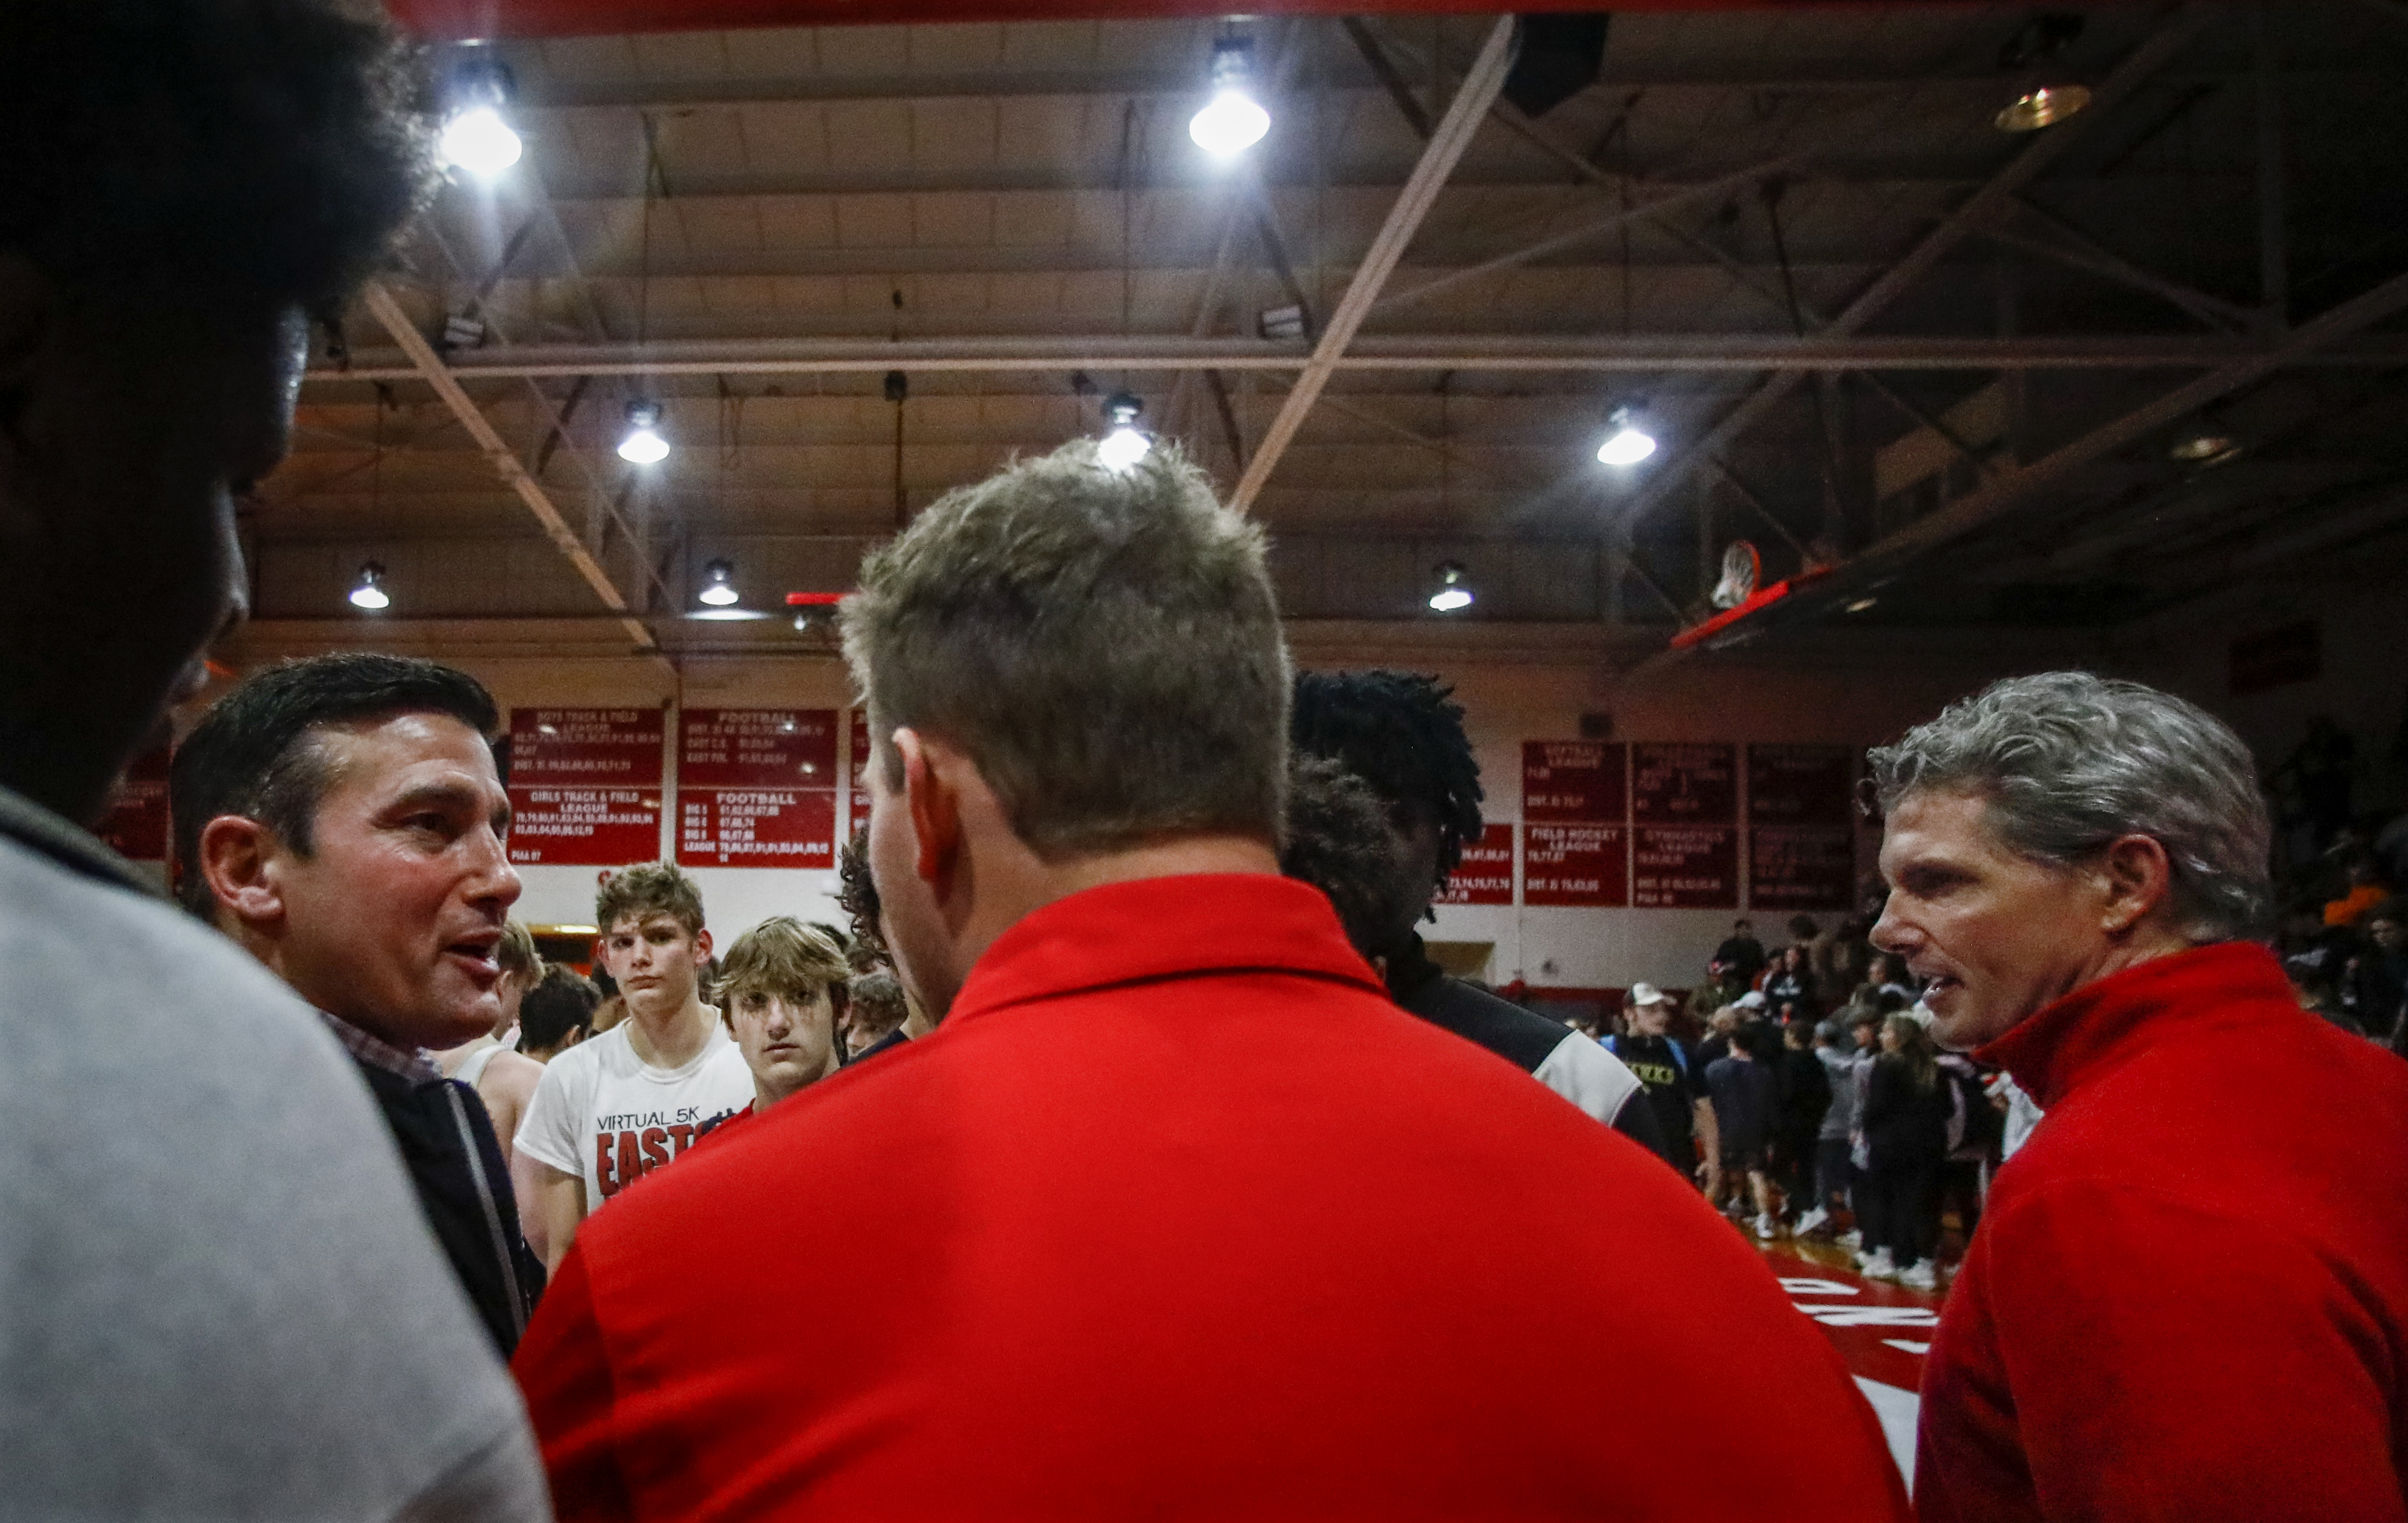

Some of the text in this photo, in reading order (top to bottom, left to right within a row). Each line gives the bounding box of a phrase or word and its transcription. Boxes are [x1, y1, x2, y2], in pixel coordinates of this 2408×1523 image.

[565, 711, 597, 722] TRACK
[719, 712, 796, 723] FOOTBALL
[563, 723, 610, 733] LEAGUE
[1549, 757, 1601, 769] LEAGUE
[531, 791, 561, 802] GIRLS
[563, 791, 597, 802] TRACK
[610, 791, 639, 802] FIELD
[717, 792, 797, 805] FOOTBALL
[560, 803, 608, 813] LEAGUE
[1532, 828, 1617, 840] FIELD HOCKEY
[684, 841, 716, 852] LEAGUE
[1549, 841, 1600, 852] LEAGUE
[511, 850, 529, 861] PIAA
[597, 1106, 700, 1130] VIRTUAL 5K
